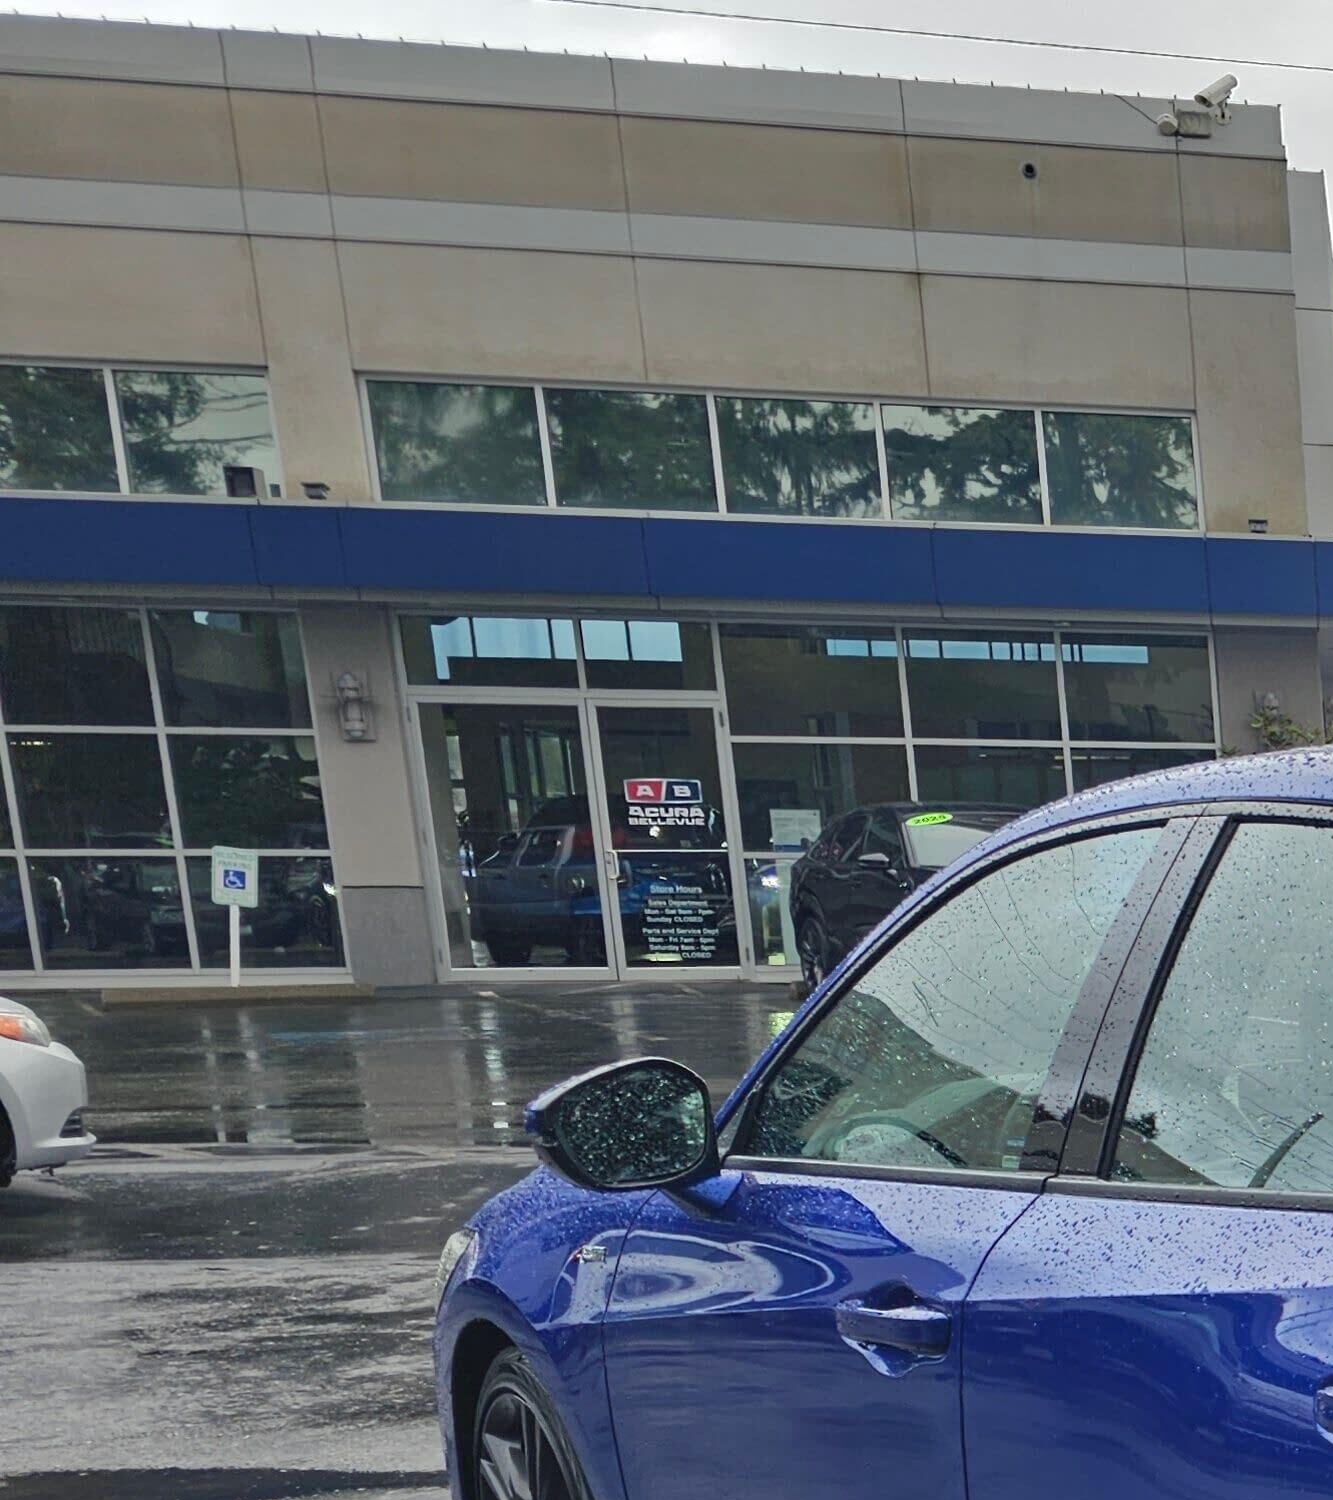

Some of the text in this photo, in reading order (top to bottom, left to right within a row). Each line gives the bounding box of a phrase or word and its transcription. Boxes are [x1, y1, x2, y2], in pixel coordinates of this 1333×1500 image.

[636, 785, 691, 797] A B
[628, 806, 705, 817] ACURA
[628, 817, 705, 826] BELLEVUE
[650, 884, 703, 894] Store Hours
[682, 951, 712, 959] CLOSED
